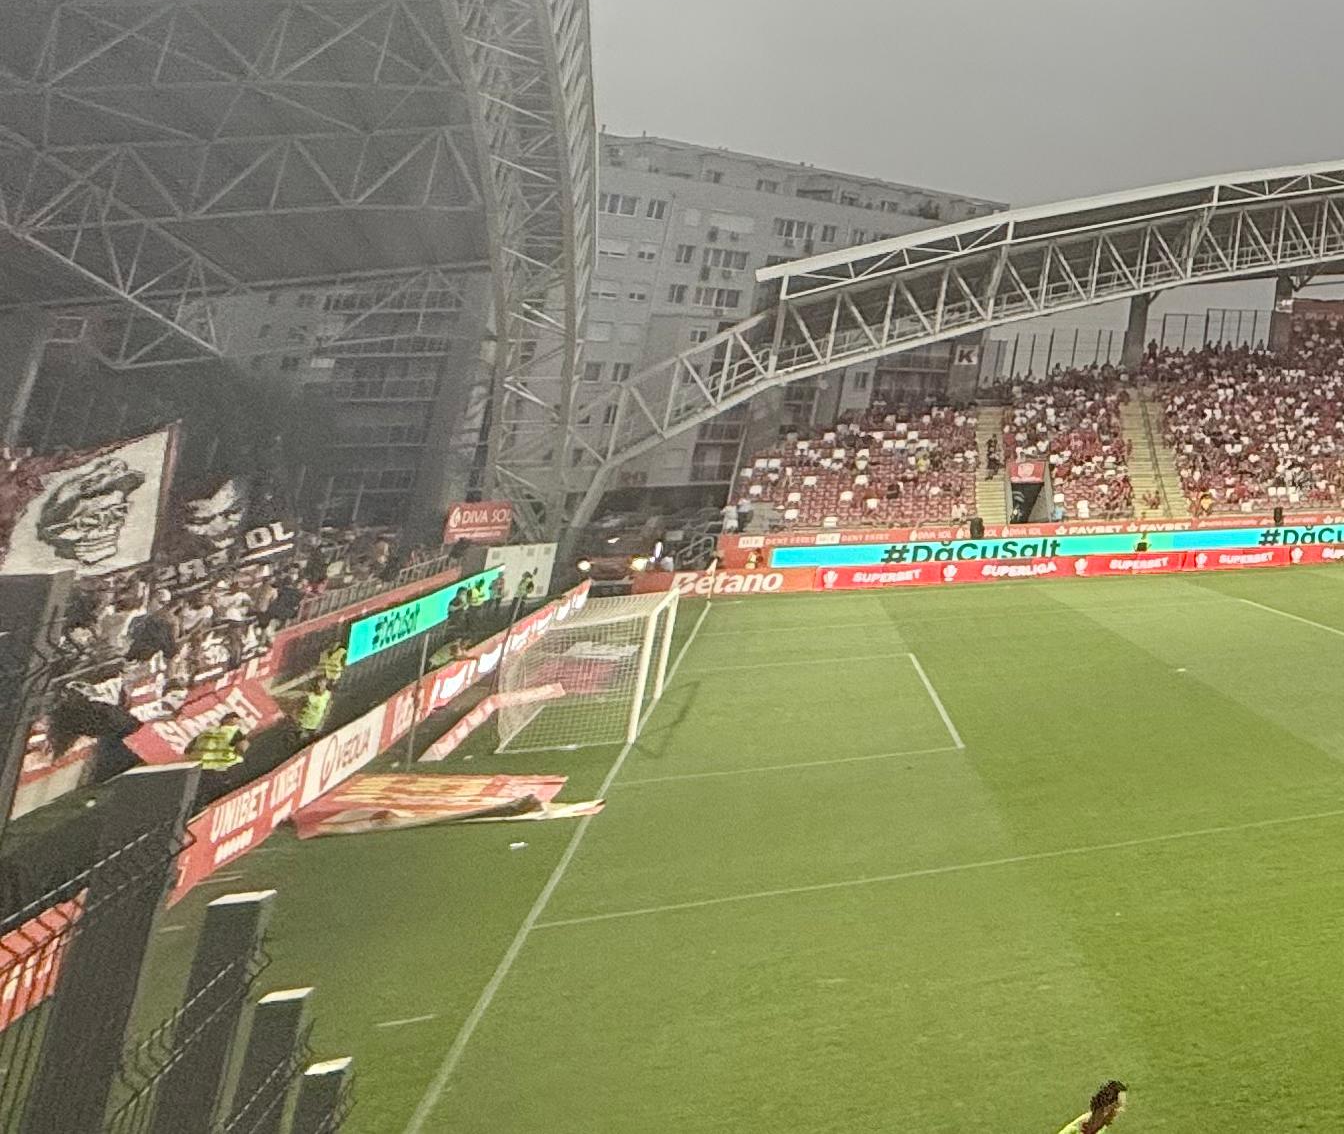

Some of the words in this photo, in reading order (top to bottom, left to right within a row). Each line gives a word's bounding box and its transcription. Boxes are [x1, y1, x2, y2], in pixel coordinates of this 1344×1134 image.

[462, 510, 488, 524] DIVA
[853, 568, 922, 584] SUPERBET
[981, 562, 1057, 577] SUPERLIGA
[670, 571, 784, 594] Betano
